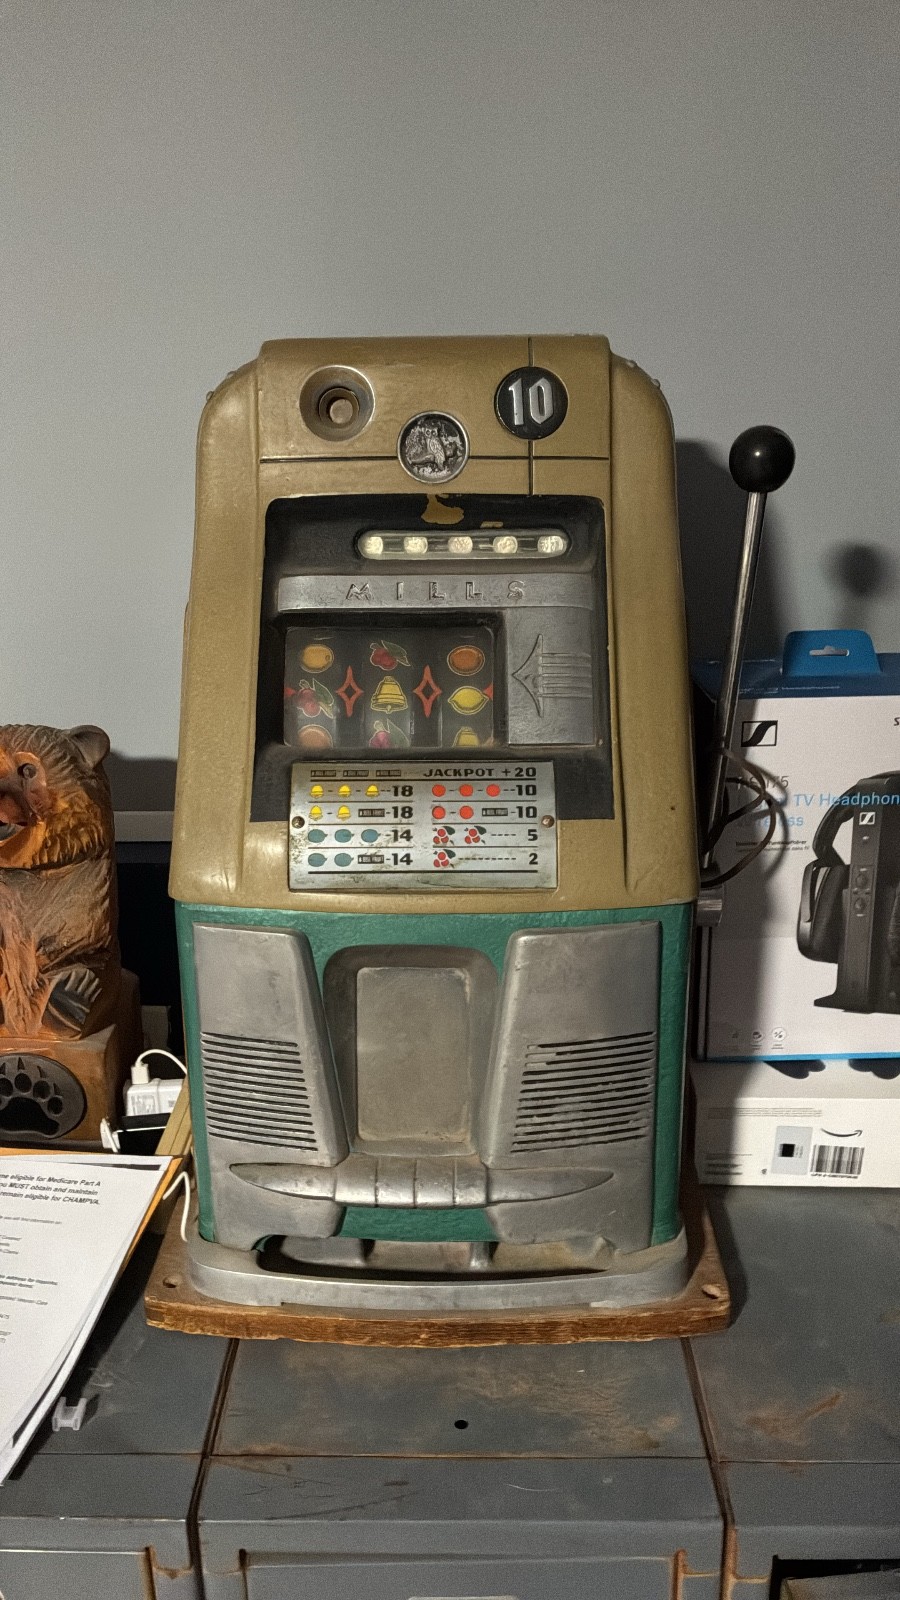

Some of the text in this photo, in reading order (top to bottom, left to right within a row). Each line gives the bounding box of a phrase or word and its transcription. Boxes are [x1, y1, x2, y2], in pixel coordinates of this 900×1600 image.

[508, 377, 553, 425] 10
[345, 580, 526, 601] MILLS
[423, 768, 494, 777] JACKPOT
[392, 785, 413, 797] 18
[516, 784, 537, 796] 10
[794, 793, 815, 807] TV
[392, 806, 413, 819] 18
[516, 806, 537, 819] 10
[392, 829, 413, 842] 14
[527, 829, 538, 841] 5
[392, 853, 413, 866] 14
[528, 853, 538, 865] 2
[10, 1174, 34, 1182] eligible
[47, 1176, 78, 1185] Medicare
[8, 1182, 30, 1190] MUST
[68, 1188, 98, 1196] maintain
[24, 1193, 49, 1201] eligible
